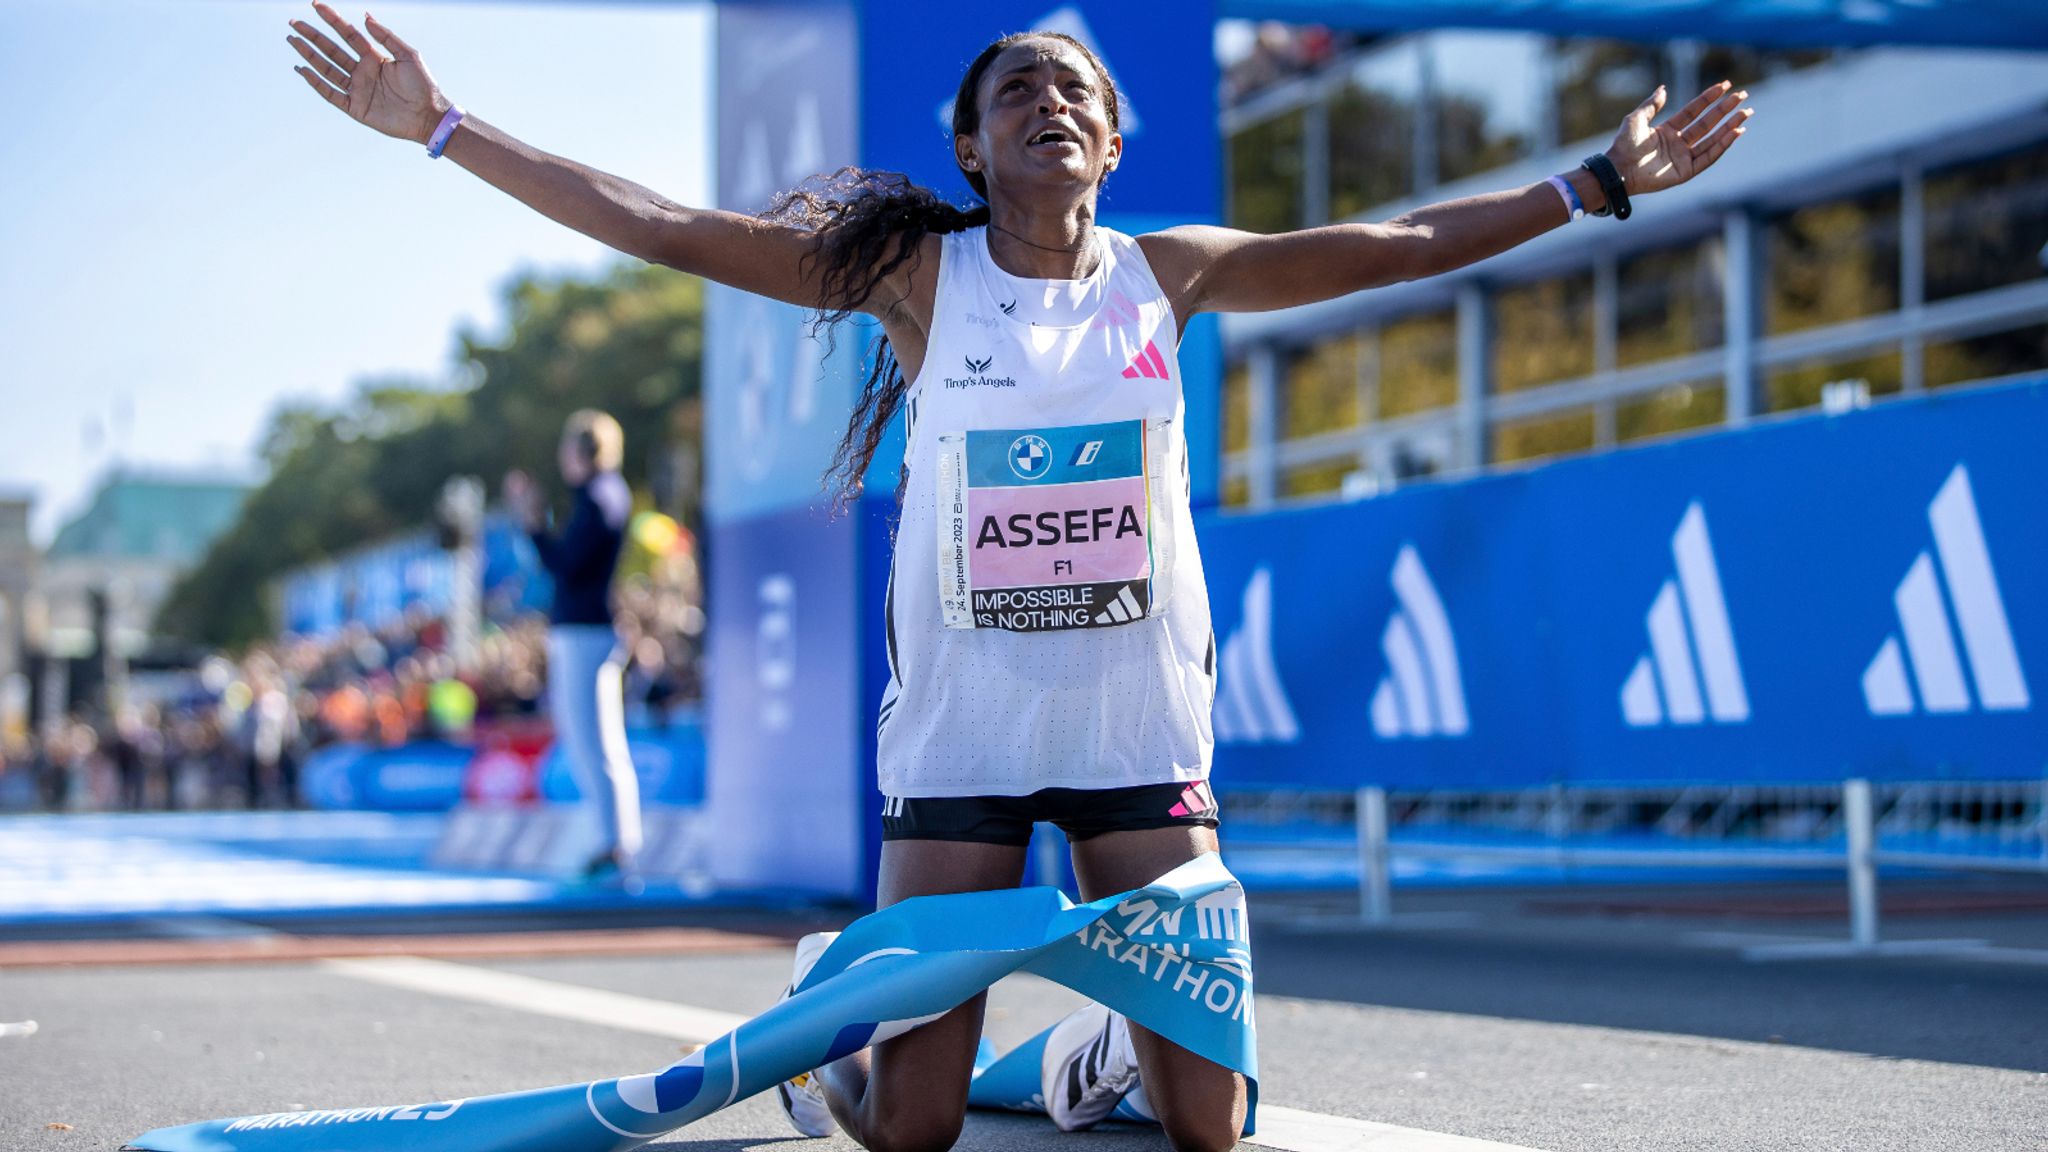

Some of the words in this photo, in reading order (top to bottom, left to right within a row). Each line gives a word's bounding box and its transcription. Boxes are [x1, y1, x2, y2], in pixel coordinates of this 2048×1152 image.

[944, 376, 976, 389] Tirop's
[978, 375, 1016, 389] Angels
[953, 517, 963, 543] 2023
[975, 504, 1143, 549] ASSEFA
[952, 544, 967, 596] September
[1053, 560, 1072, 576] F1
[974, 587, 1093, 610] IMPOSSIBLE
[976, 612, 994, 627] IS
[998, 608, 1090, 628] NOTHING
